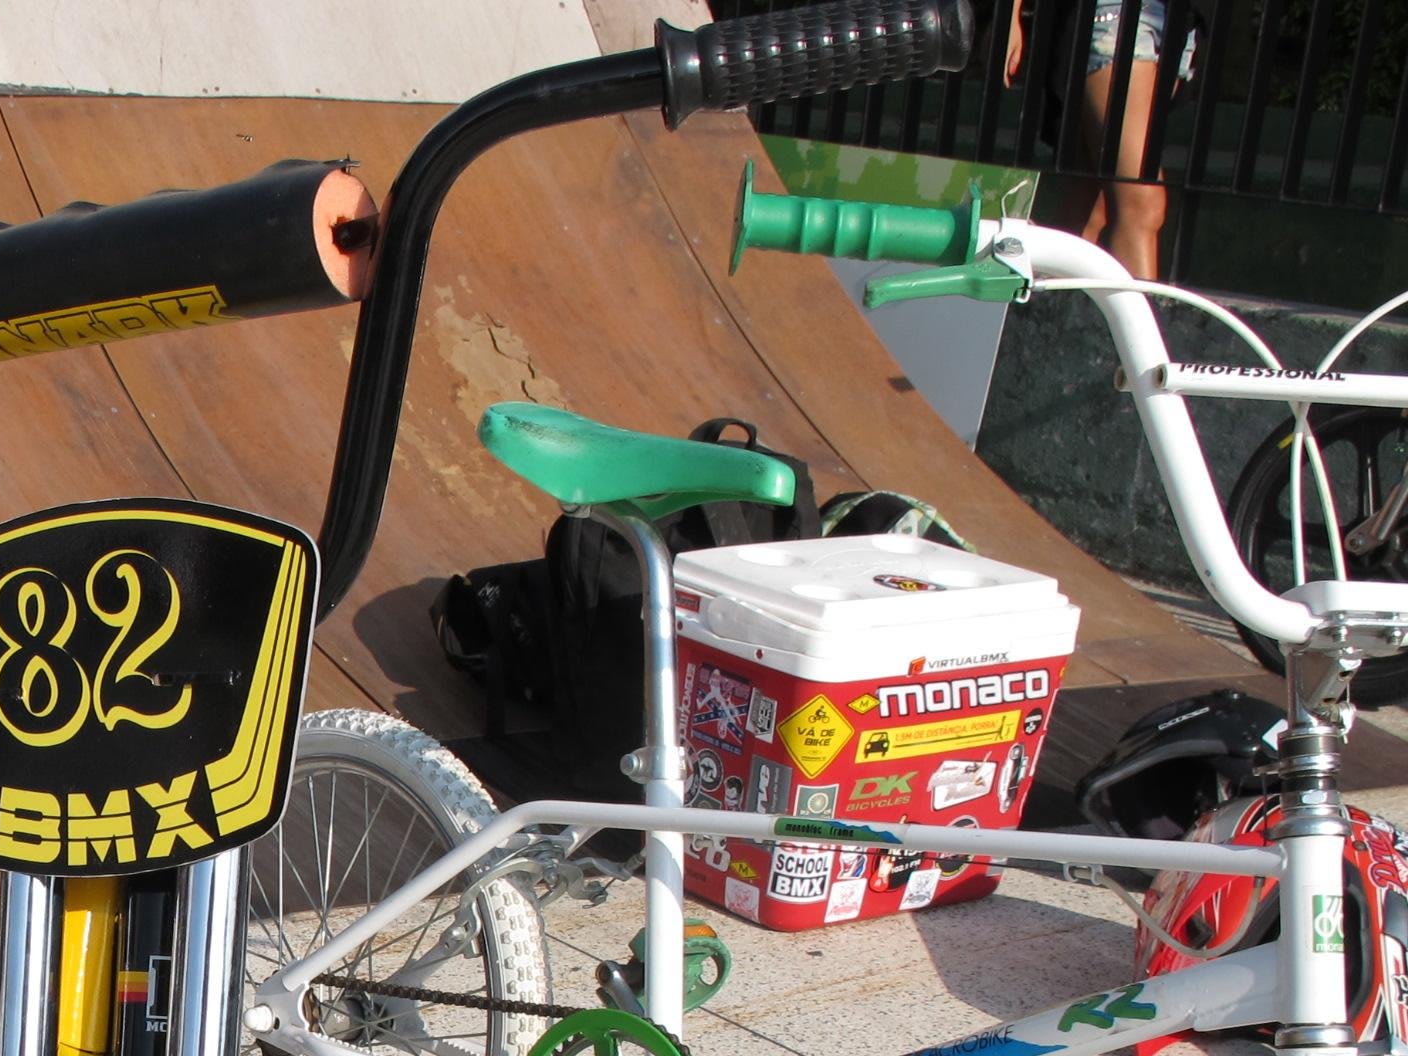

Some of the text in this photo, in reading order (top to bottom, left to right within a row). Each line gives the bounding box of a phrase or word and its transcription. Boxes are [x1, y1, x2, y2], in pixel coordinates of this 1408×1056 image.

[1179, 362, 1346, 381] PROFESSIONAL
[928, 652, 1009, 669] VIRTUALBMX
[879, 669, 1049, 718] monaco
[796, 725, 836, 737] VÁ DE
[804, 738, 832, 747] BIKE
[850, 771, 920, 800] DK
[846, 795, 912, 812] BICYCLES
[776, 854, 829, 874] SCHOOL
[775, 875, 826, 898] BMX
